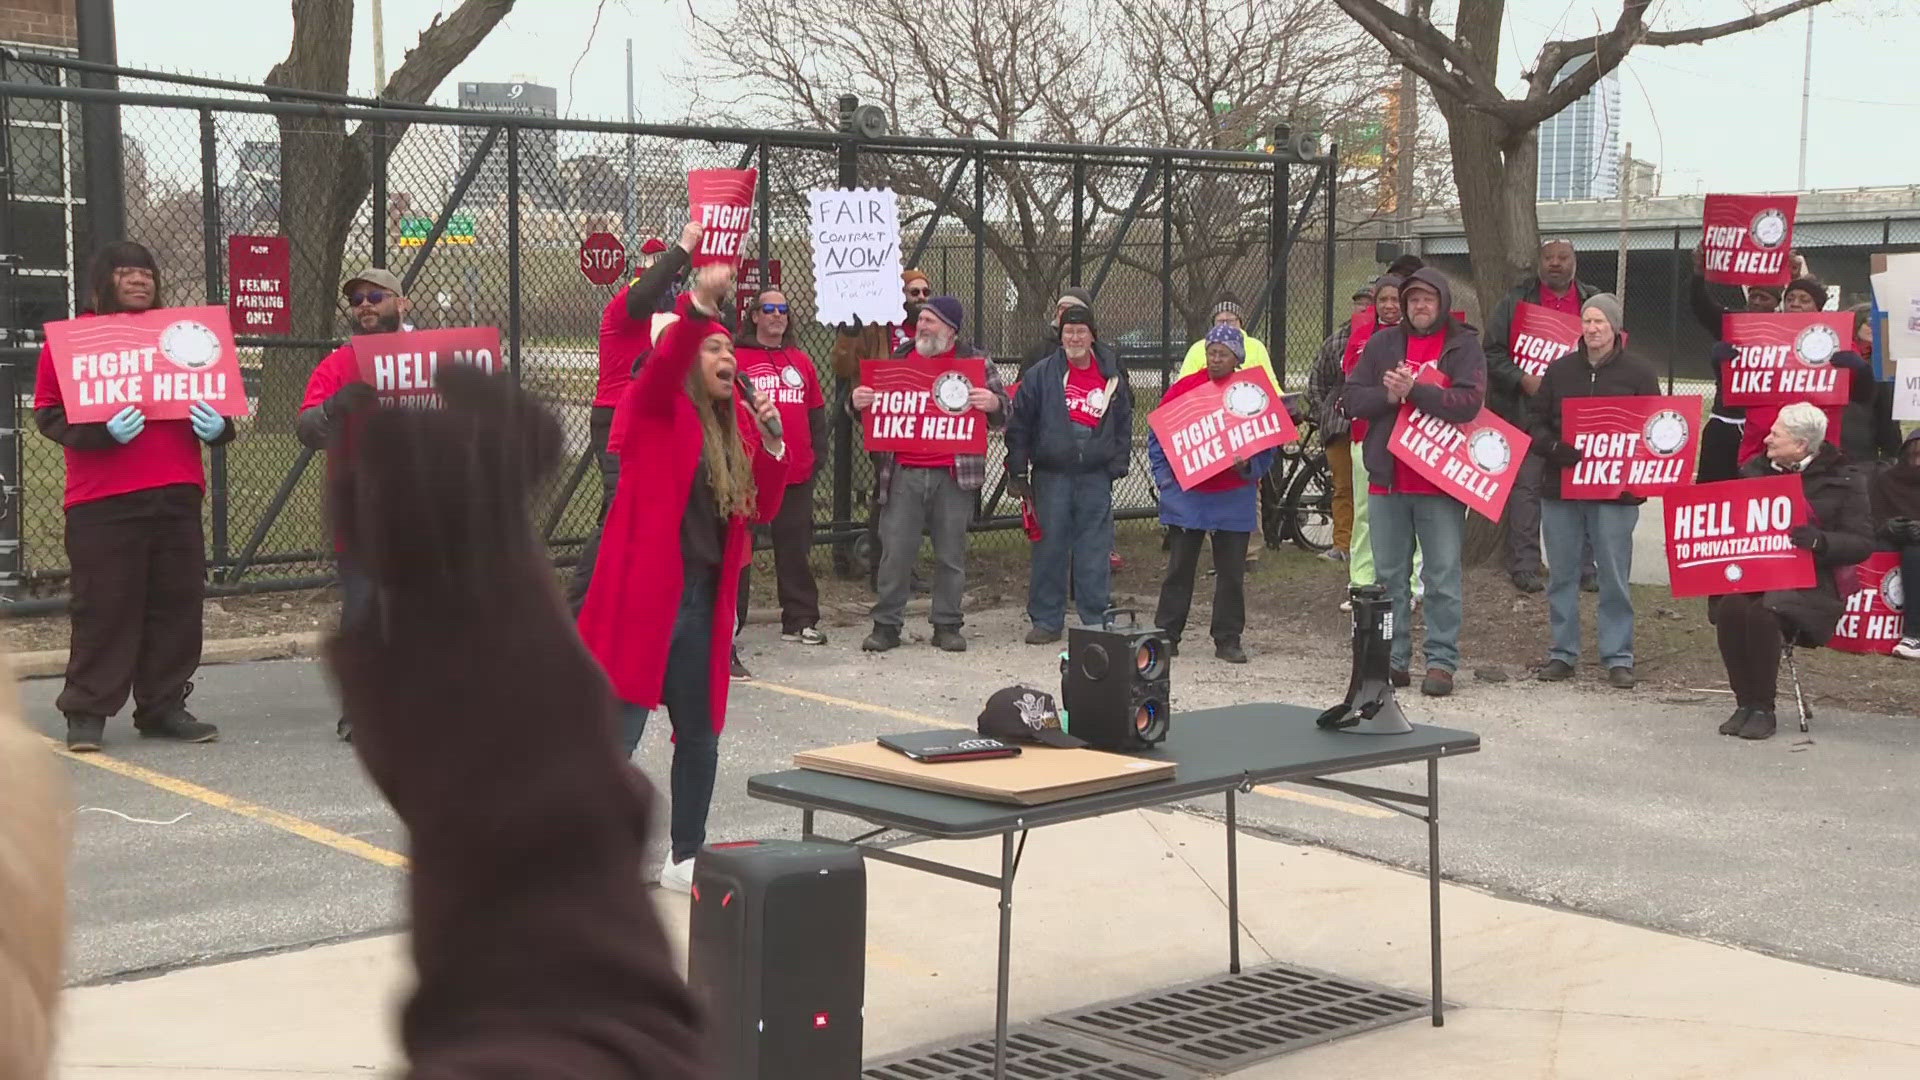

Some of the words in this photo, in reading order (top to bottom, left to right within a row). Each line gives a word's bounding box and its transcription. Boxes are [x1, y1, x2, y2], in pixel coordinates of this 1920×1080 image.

[702, 205, 750, 230] FIGHT
[820, 200, 885, 224] FAIR
[700, 230, 738, 256] LIKE
[819, 230, 886, 244] CONTRACT
[1704, 225, 1748, 249] FIGHT
[582, 249, 623, 270] STOP
[825, 242, 894, 269] NOW!
[1705, 249, 1731, 272] LIKE
[1734, 251, 1784, 274] HELL!
[236, 294, 284, 309] PARKING
[246, 311, 274, 325] ONLY
[1513, 333, 1571, 362] FIGHT
[1731, 344, 1791, 369] FIGHT
[72, 347, 158, 381] FIGHT
[79, 375, 143, 407] LIKE
[153, 372, 227, 401] HELL!
[1730, 369, 1774, 393] LIKE
[1779, 369, 1837, 393] HELL!
[871, 391, 930, 415] FIGHT
[873, 415, 917, 438] LIKE
[921, 416, 975, 440] HELL!
[1171, 407, 1227, 457] FIGHT
[1408, 407, 1467, 453] FIGHT
[1182, 436, 1226, 477] LIKE
[1227, 412, 1281, 452] HELL!
[1574, 432, 1641, 458] FIGHT
[1399, 425, 1445, 468] LIKE
[1441, 456, 1500, 503] HELL!
[1572, 460, 1624, 484] LIKE
[1627, 459, 1684, 484] HELL!
[1674, 501, 1735, 540] HELL
[1746, 495, 1792, 533] NO
[1676, 543, 1691, 560] TO
